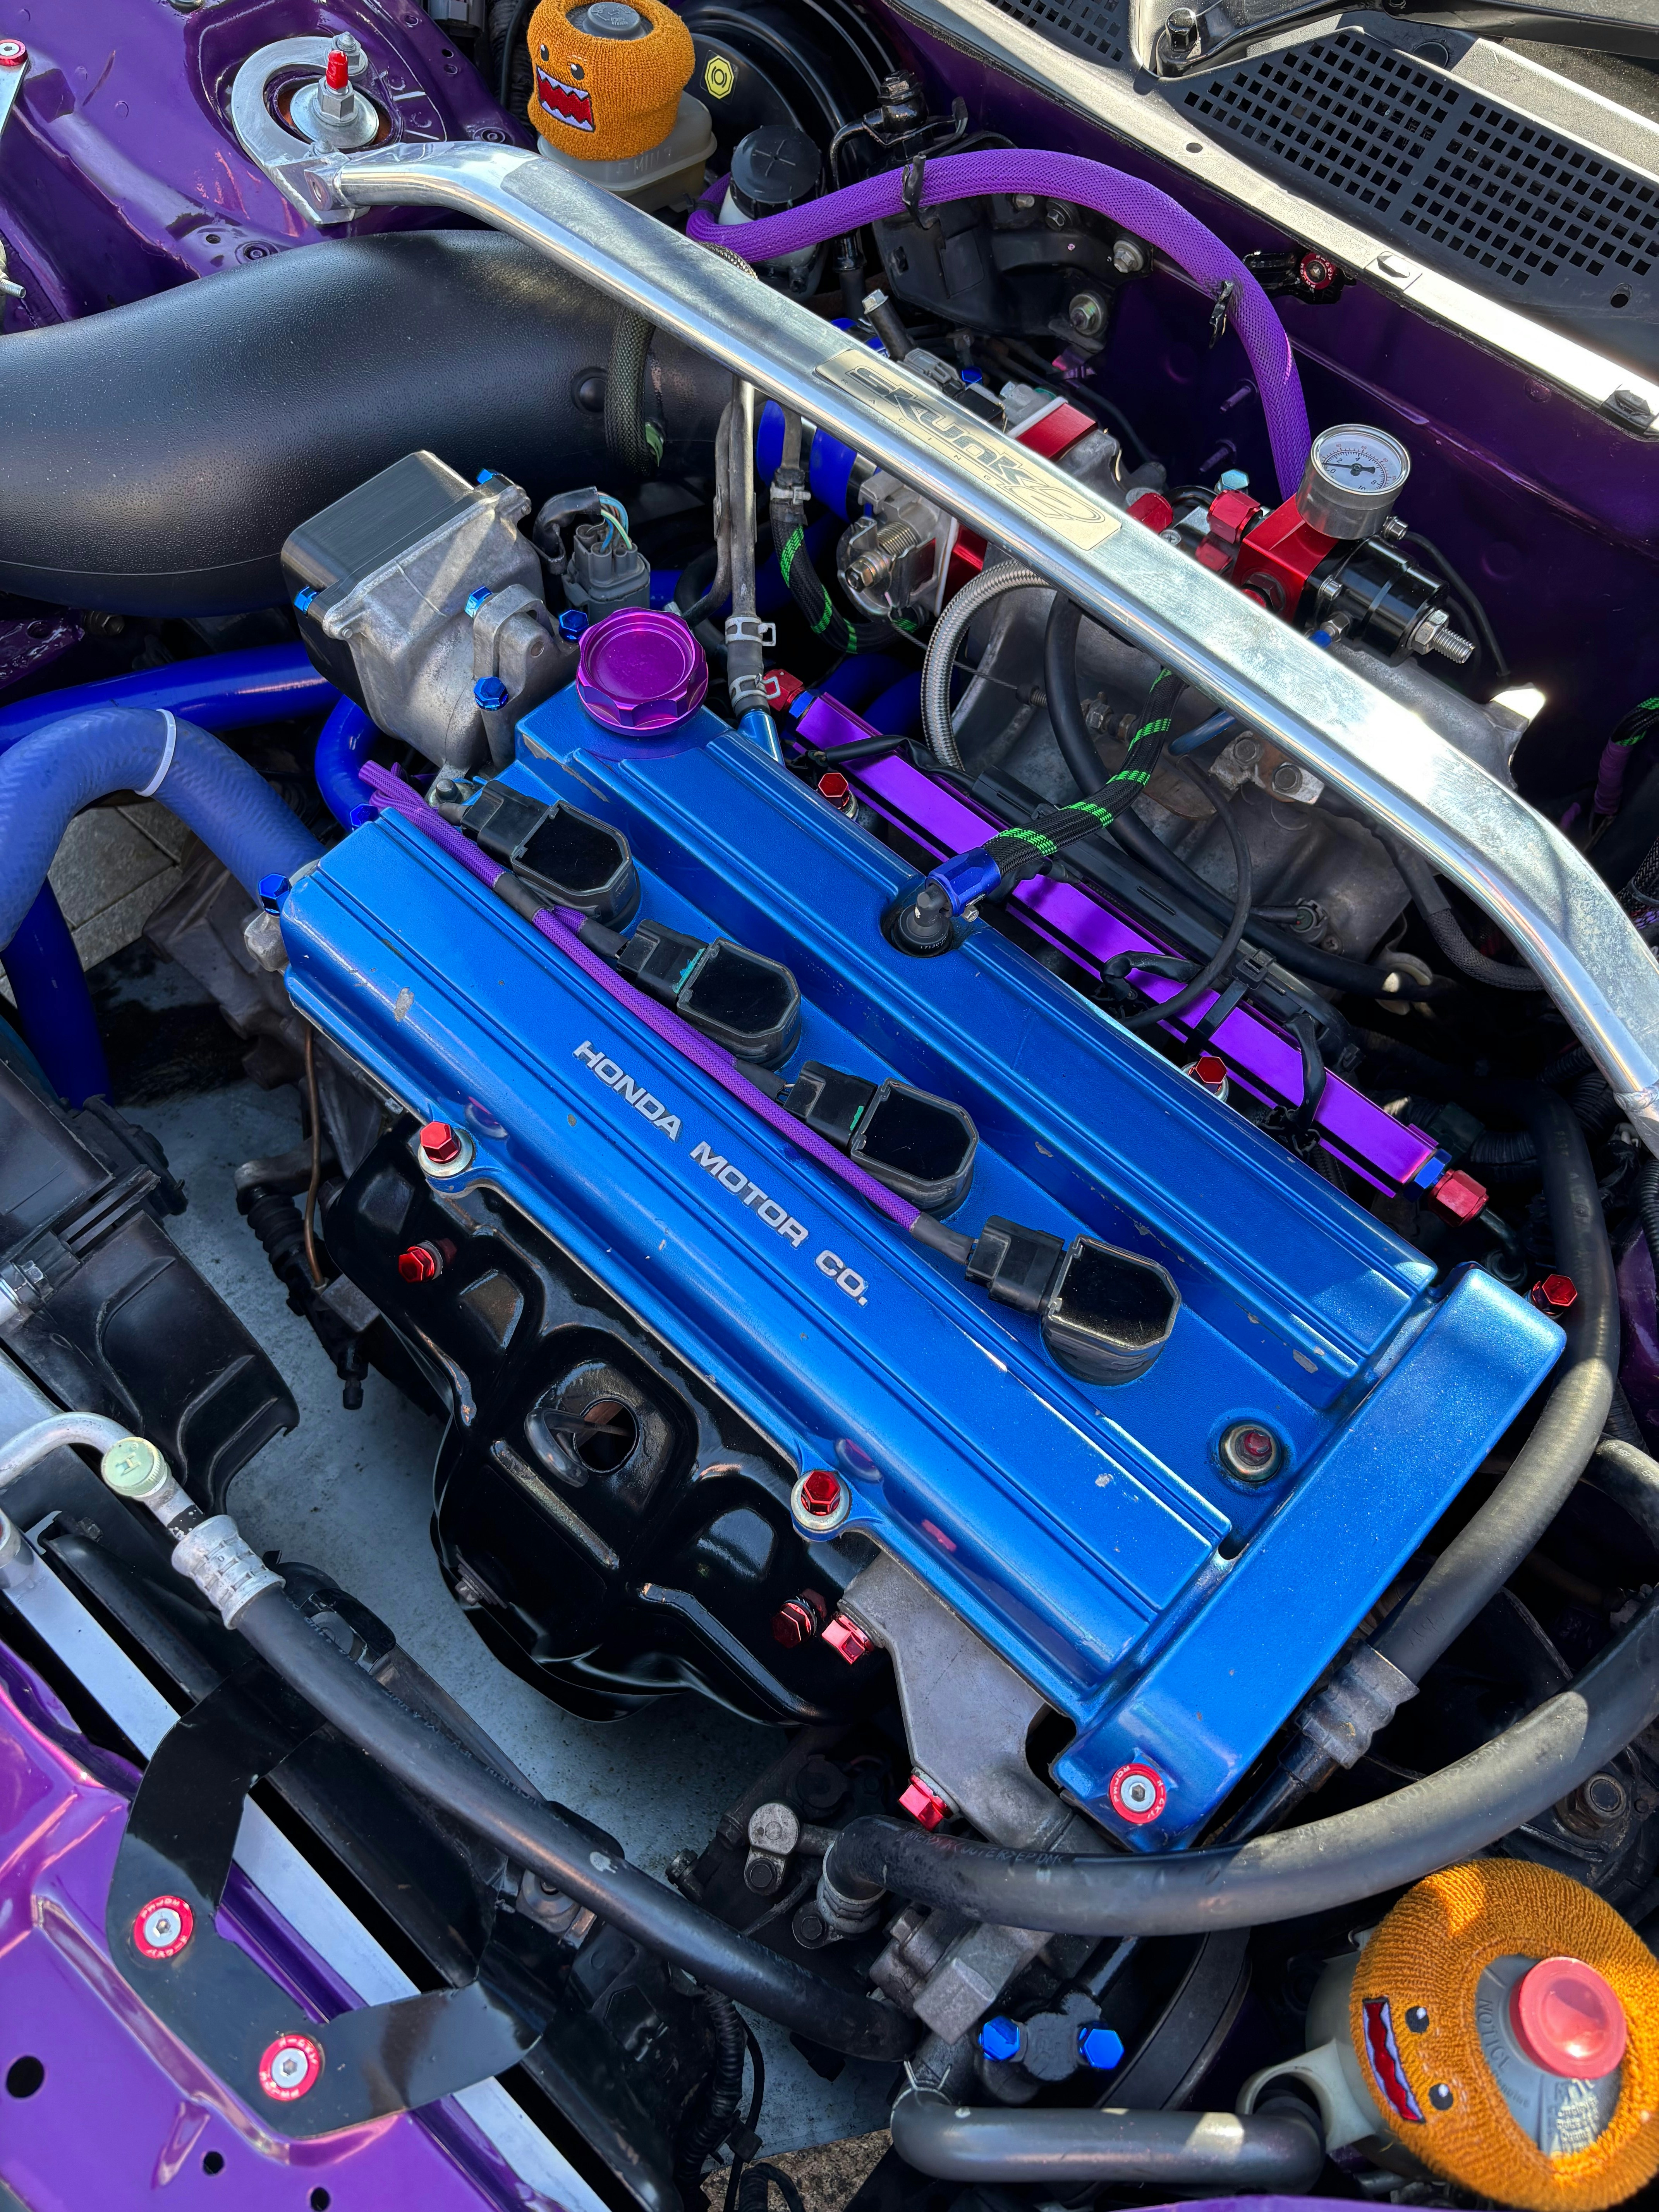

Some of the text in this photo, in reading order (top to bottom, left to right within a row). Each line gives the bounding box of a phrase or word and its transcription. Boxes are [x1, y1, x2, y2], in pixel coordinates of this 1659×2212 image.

[573, 1040, 869, 1306] HONDA MOTOR CO.
